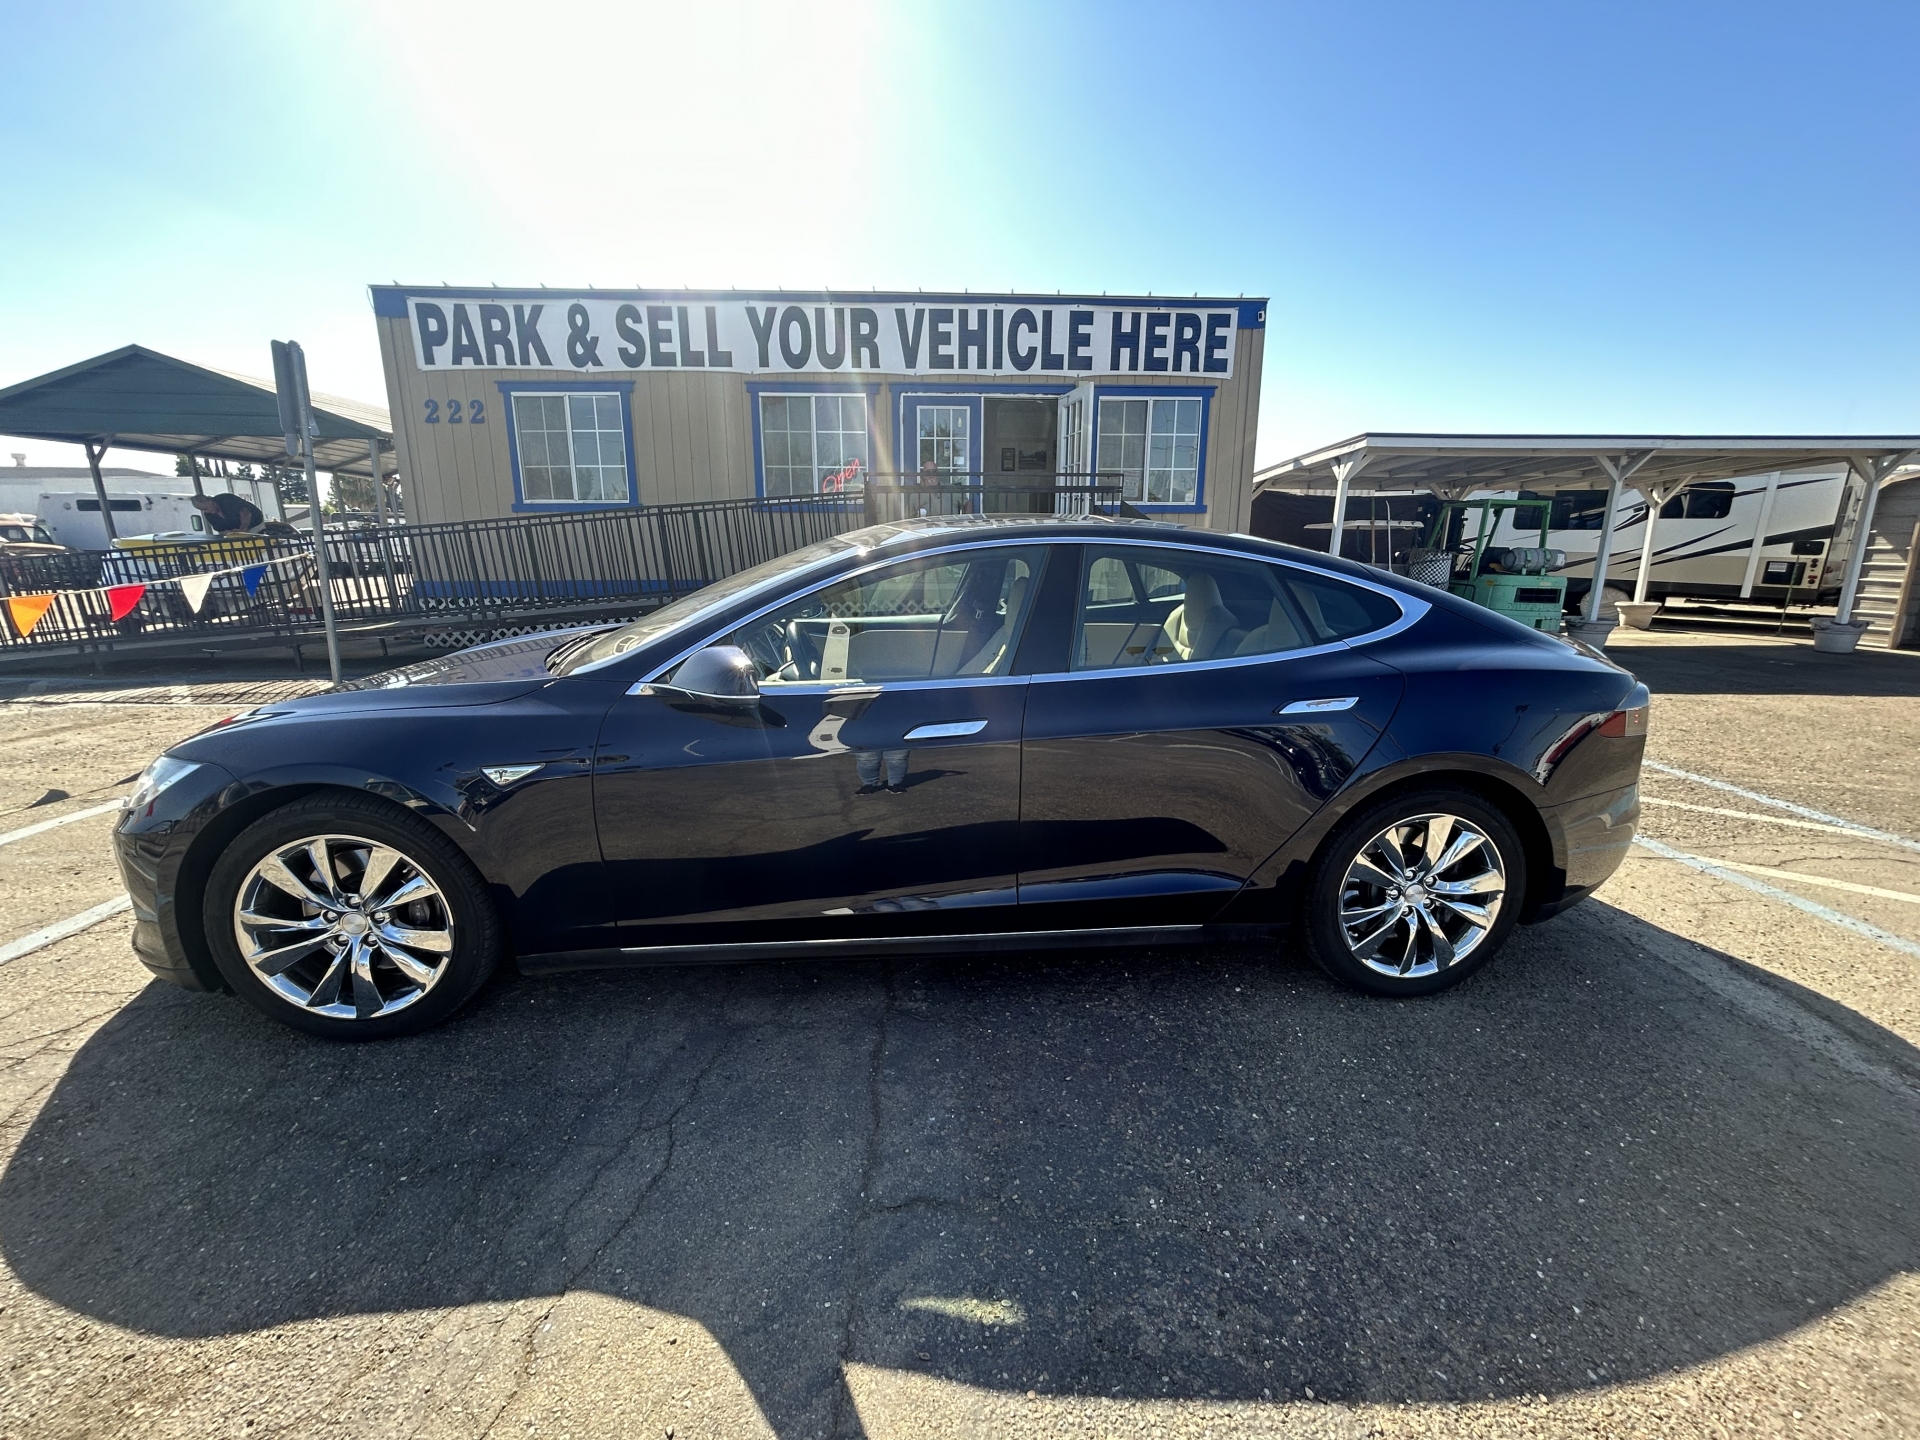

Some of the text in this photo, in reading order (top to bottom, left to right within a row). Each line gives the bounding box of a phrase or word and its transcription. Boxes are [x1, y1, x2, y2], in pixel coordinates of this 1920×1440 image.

[414, 302, 1232, 374] PARK & SELL YOUR VEHICLE HERE
[423, 399, 486, 424] 222
